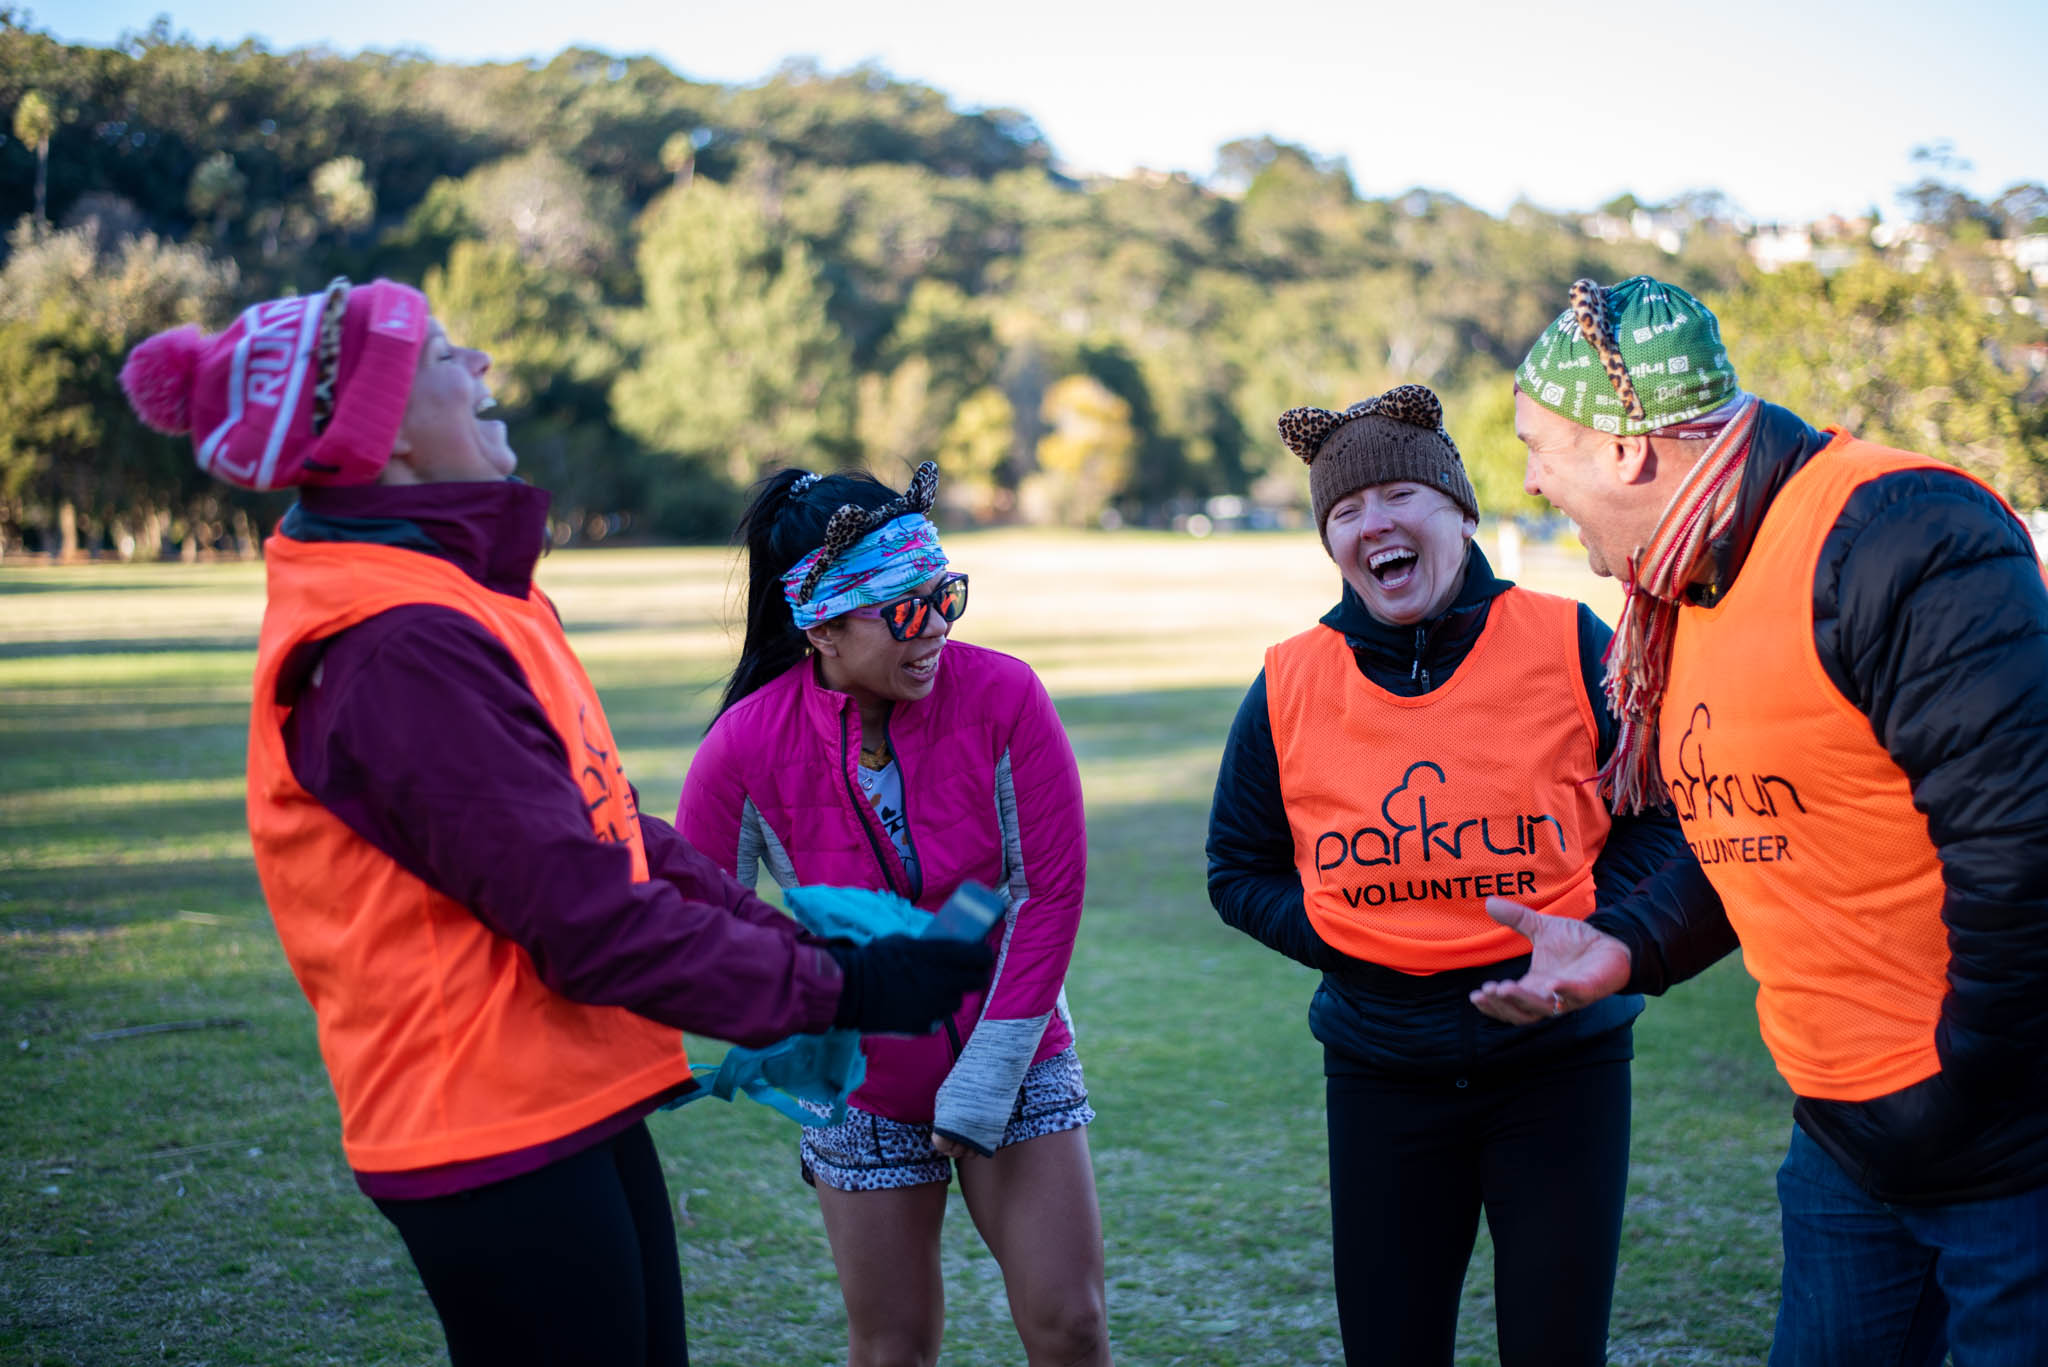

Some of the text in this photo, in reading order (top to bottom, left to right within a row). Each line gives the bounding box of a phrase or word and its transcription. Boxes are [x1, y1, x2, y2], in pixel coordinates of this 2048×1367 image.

[1665, 703, 1807, 821] arkrun
[1315, 761, 1566, 884] parkrun
[1689, 835, 1793, 864] OLUNTEER
[1342, 871, 1537, 908] VOLUNTEER
